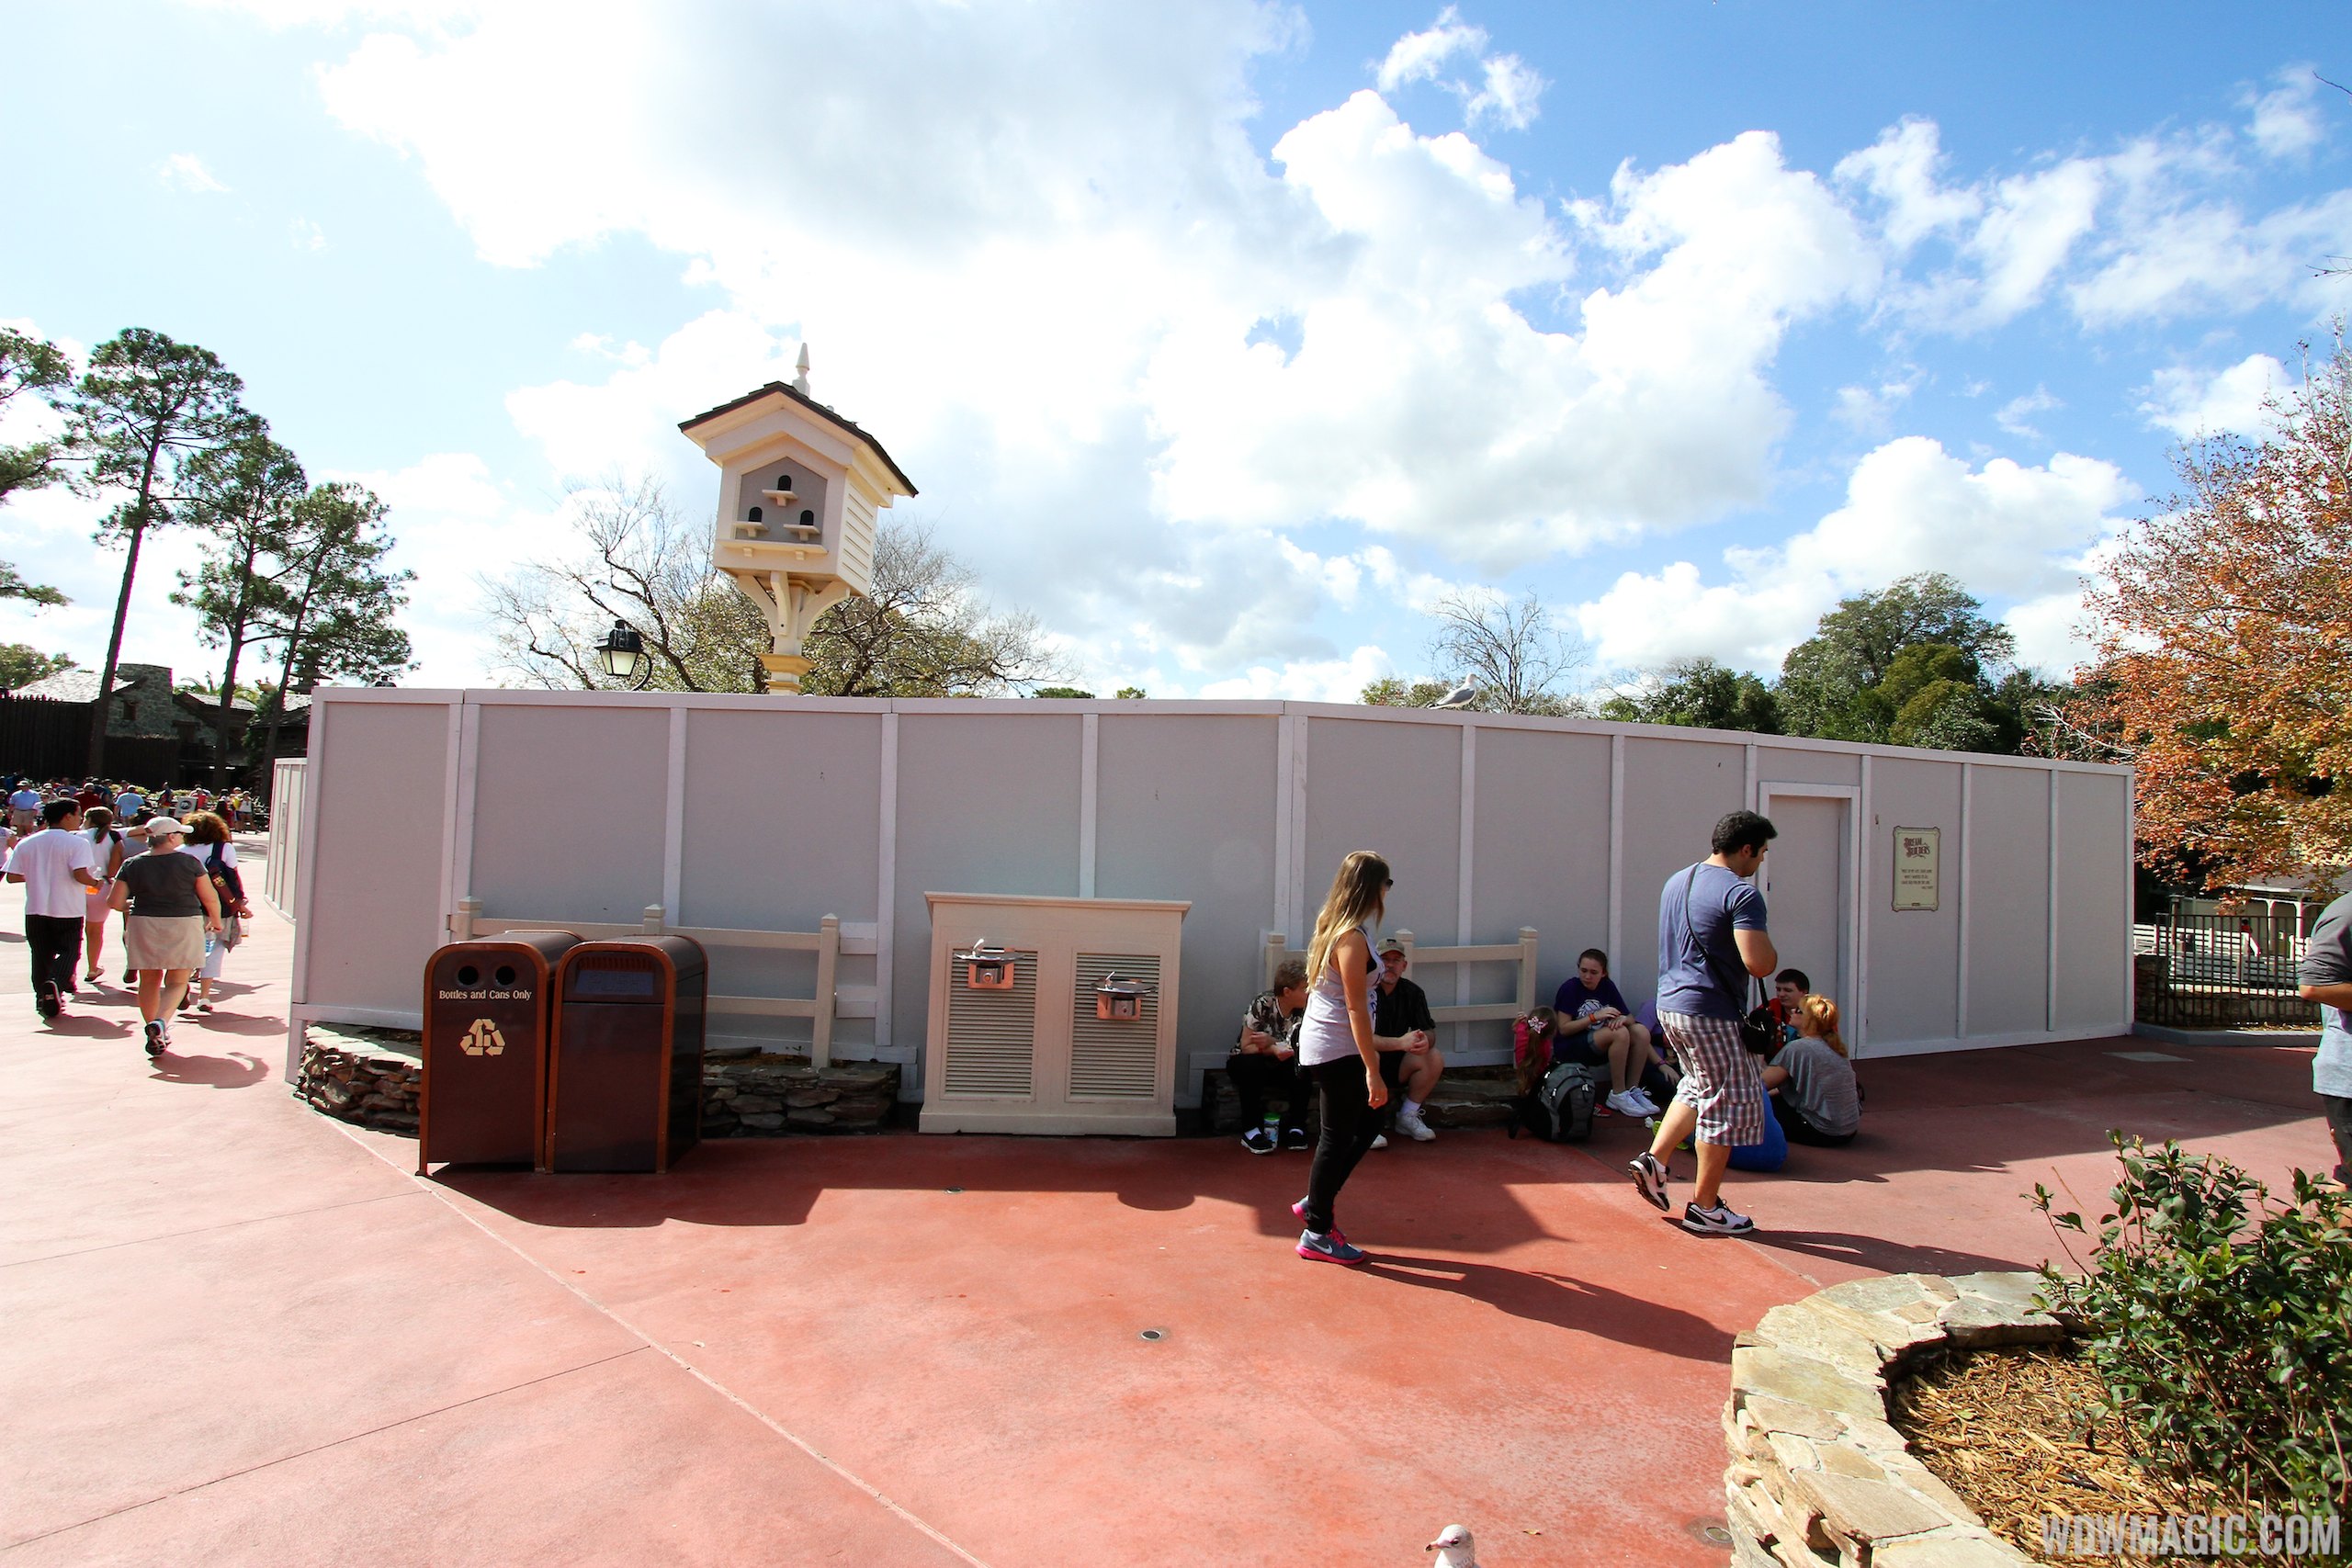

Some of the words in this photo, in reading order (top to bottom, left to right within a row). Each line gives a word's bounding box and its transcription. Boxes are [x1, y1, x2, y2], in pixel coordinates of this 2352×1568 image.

[439, 990, 468, 999] Bottles
[470, 990, 487, 999] and
[489, 990, 510, 999] Cans
[513, 990, 532, 1001] Only
